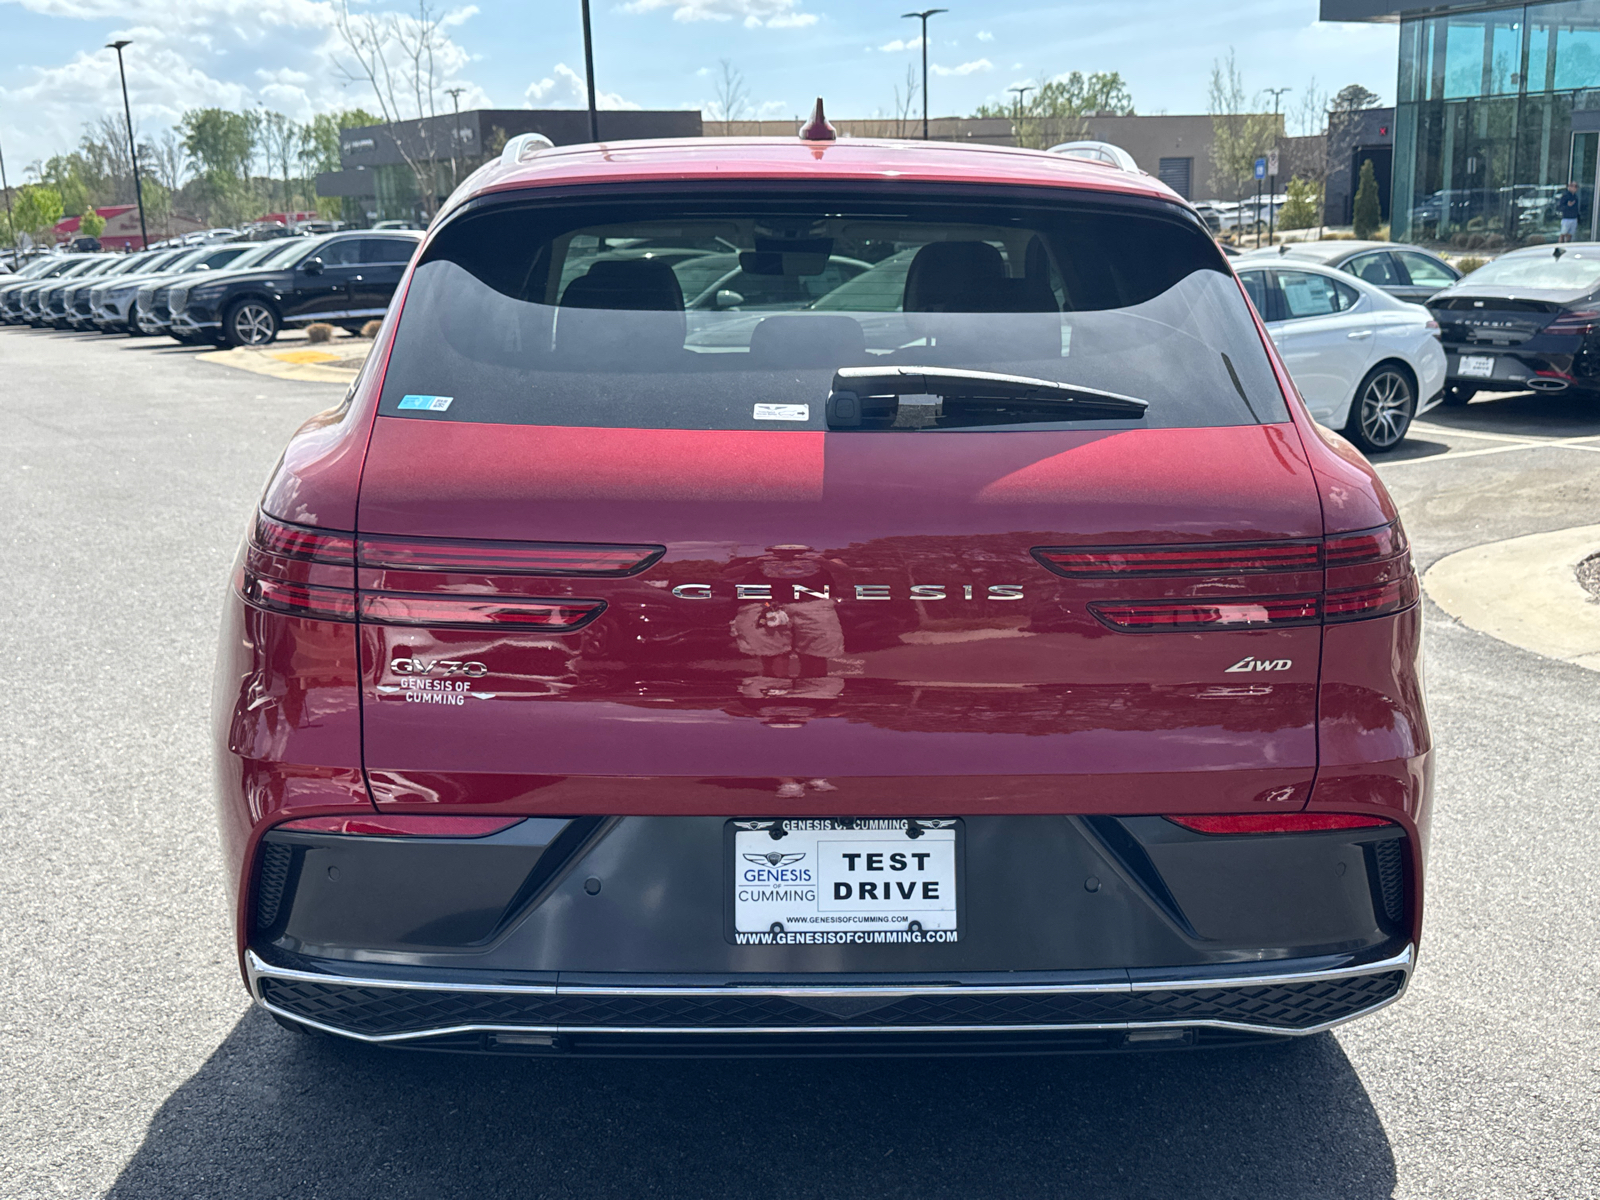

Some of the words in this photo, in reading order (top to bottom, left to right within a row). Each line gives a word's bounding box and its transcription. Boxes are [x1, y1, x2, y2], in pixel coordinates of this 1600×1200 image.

[671, 584, 1024, 600] GENESIS
[390, 658, 488, 678] GV70
[401, 679, 452, 690] GENESIS
[455, 681, 471, 692] OF
[406, 692, 464, 705] CUMMING
[782, 820, 832, 830] GENESIS
[853, 819, 908, 830] CUMMING
[842, 853, 931, 871] TEST
[743, 869, 812, 882] GENESIS
[738, 889, 816, 902] CUMMING
[833, 881, 940, 900] DRIVE
[786, 916, 909, 924] WWW.GENESISOFCUMMING.COM
[735, 931, 958, 945] WWW.GENESISOFCUMMING.COM
